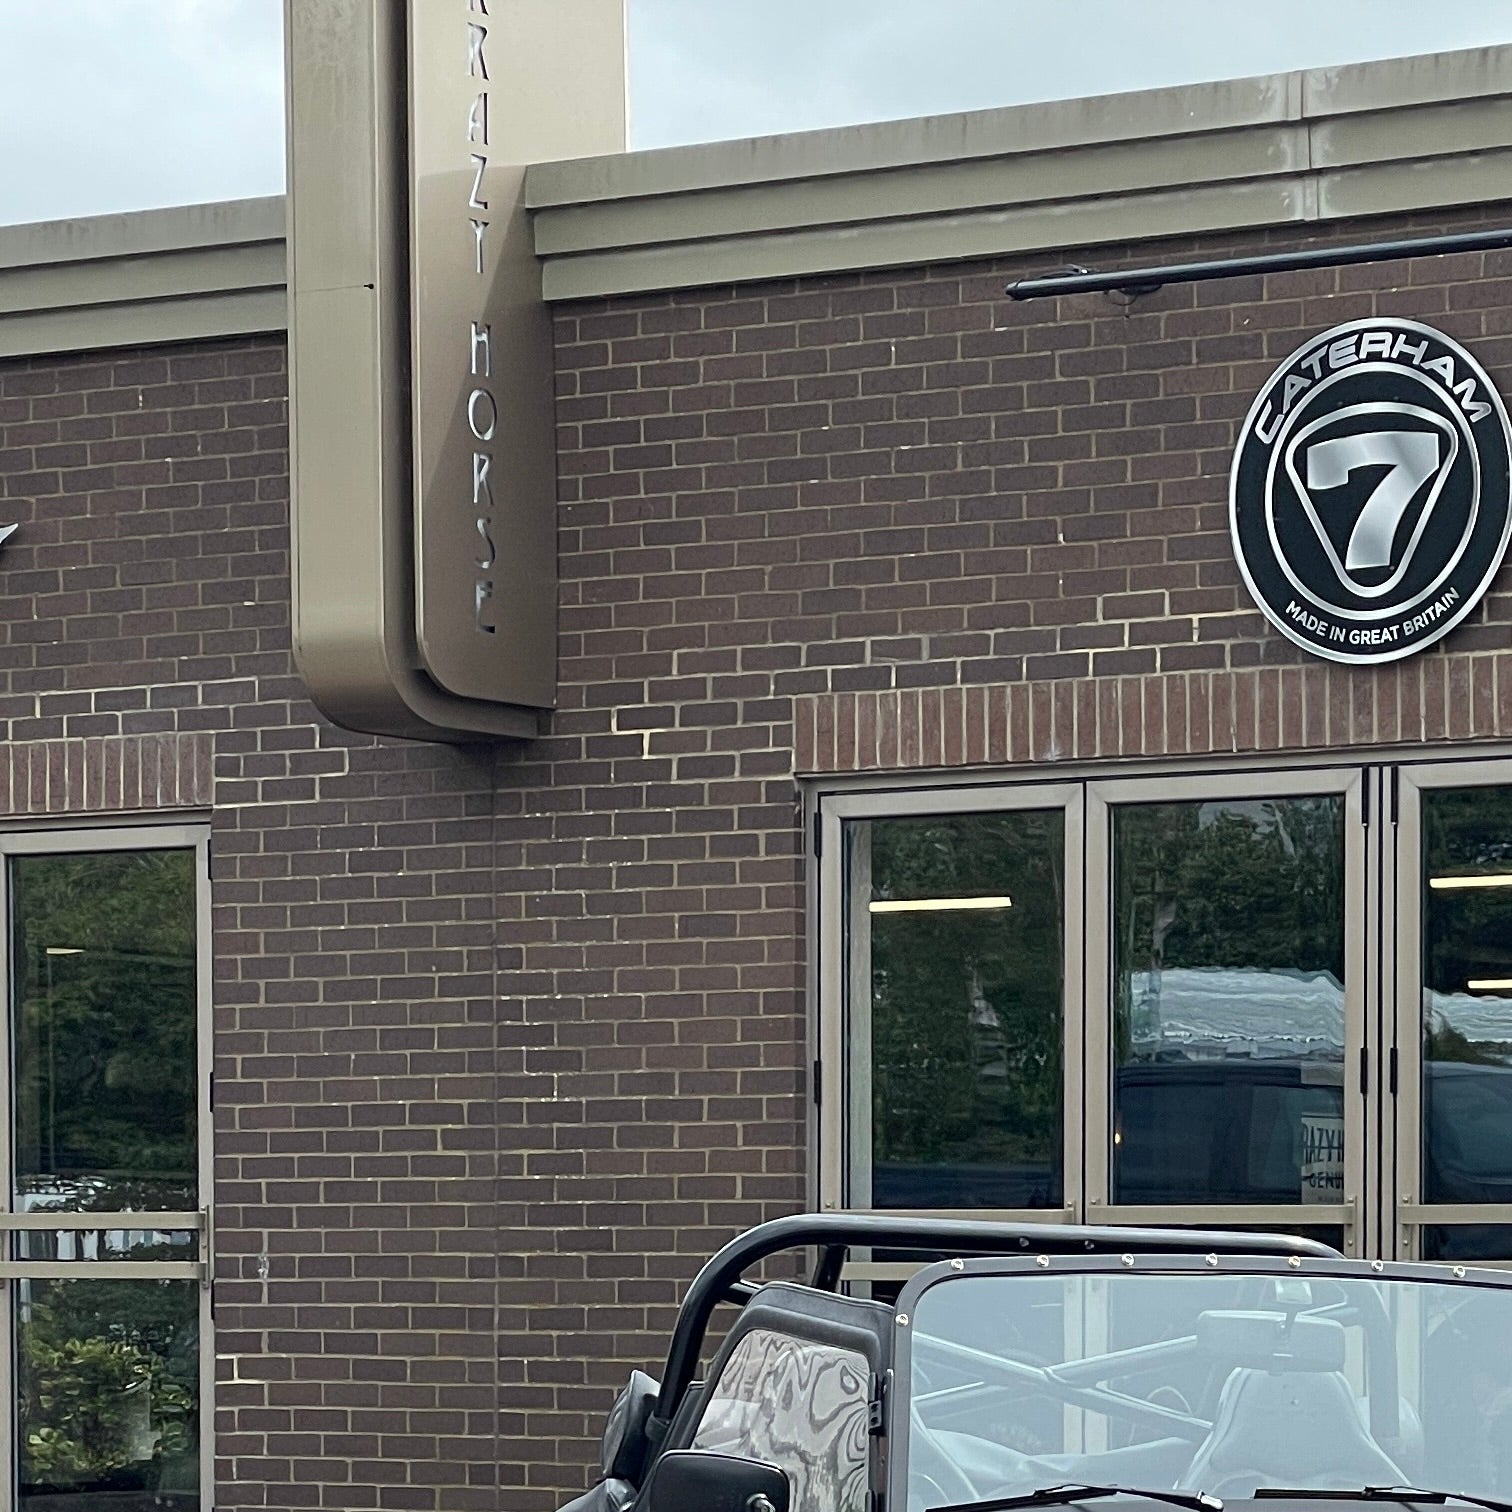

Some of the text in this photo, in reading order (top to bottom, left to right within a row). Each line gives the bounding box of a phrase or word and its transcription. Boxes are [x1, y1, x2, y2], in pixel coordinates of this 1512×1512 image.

[466, 0, 499, 635] RAZY HORSE
[1254, 332, 1493, 444] CATERHAM
[1306, 431, 1440, 570] 7
[1285, 586, 1460, 645] MADE IN GREAT BRITAIN
